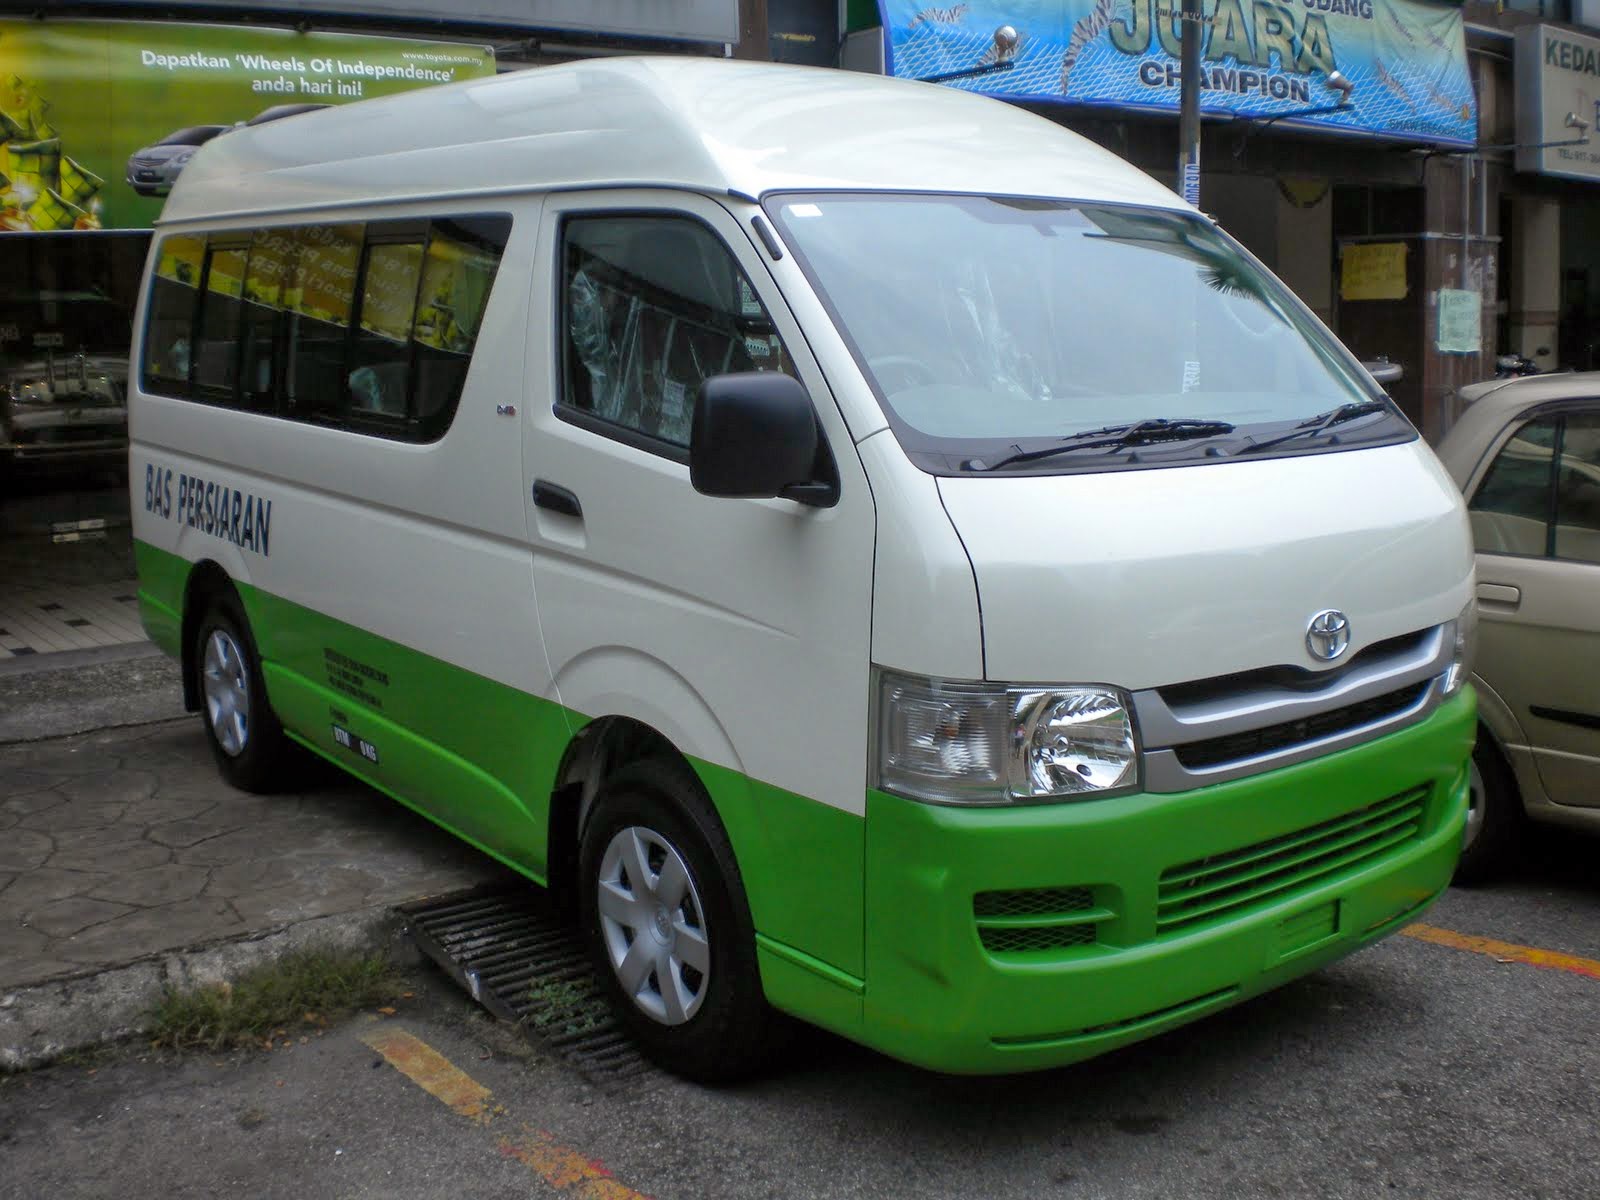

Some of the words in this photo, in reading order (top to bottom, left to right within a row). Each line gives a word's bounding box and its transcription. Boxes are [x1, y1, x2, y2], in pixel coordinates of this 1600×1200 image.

[142, 50, 231, 70] Dapatkan
[310, 59, 333, 73] Of
[402, 52, 483, 66] www.toyota.com.my
[252, 76, 295, 92] anda
[300, 77, 332, 95] hari
[337, 81, 362, 96] ini!
[145, 463, 172, 519] BAS
[178, 473, 271, 557] PERSIARAN
